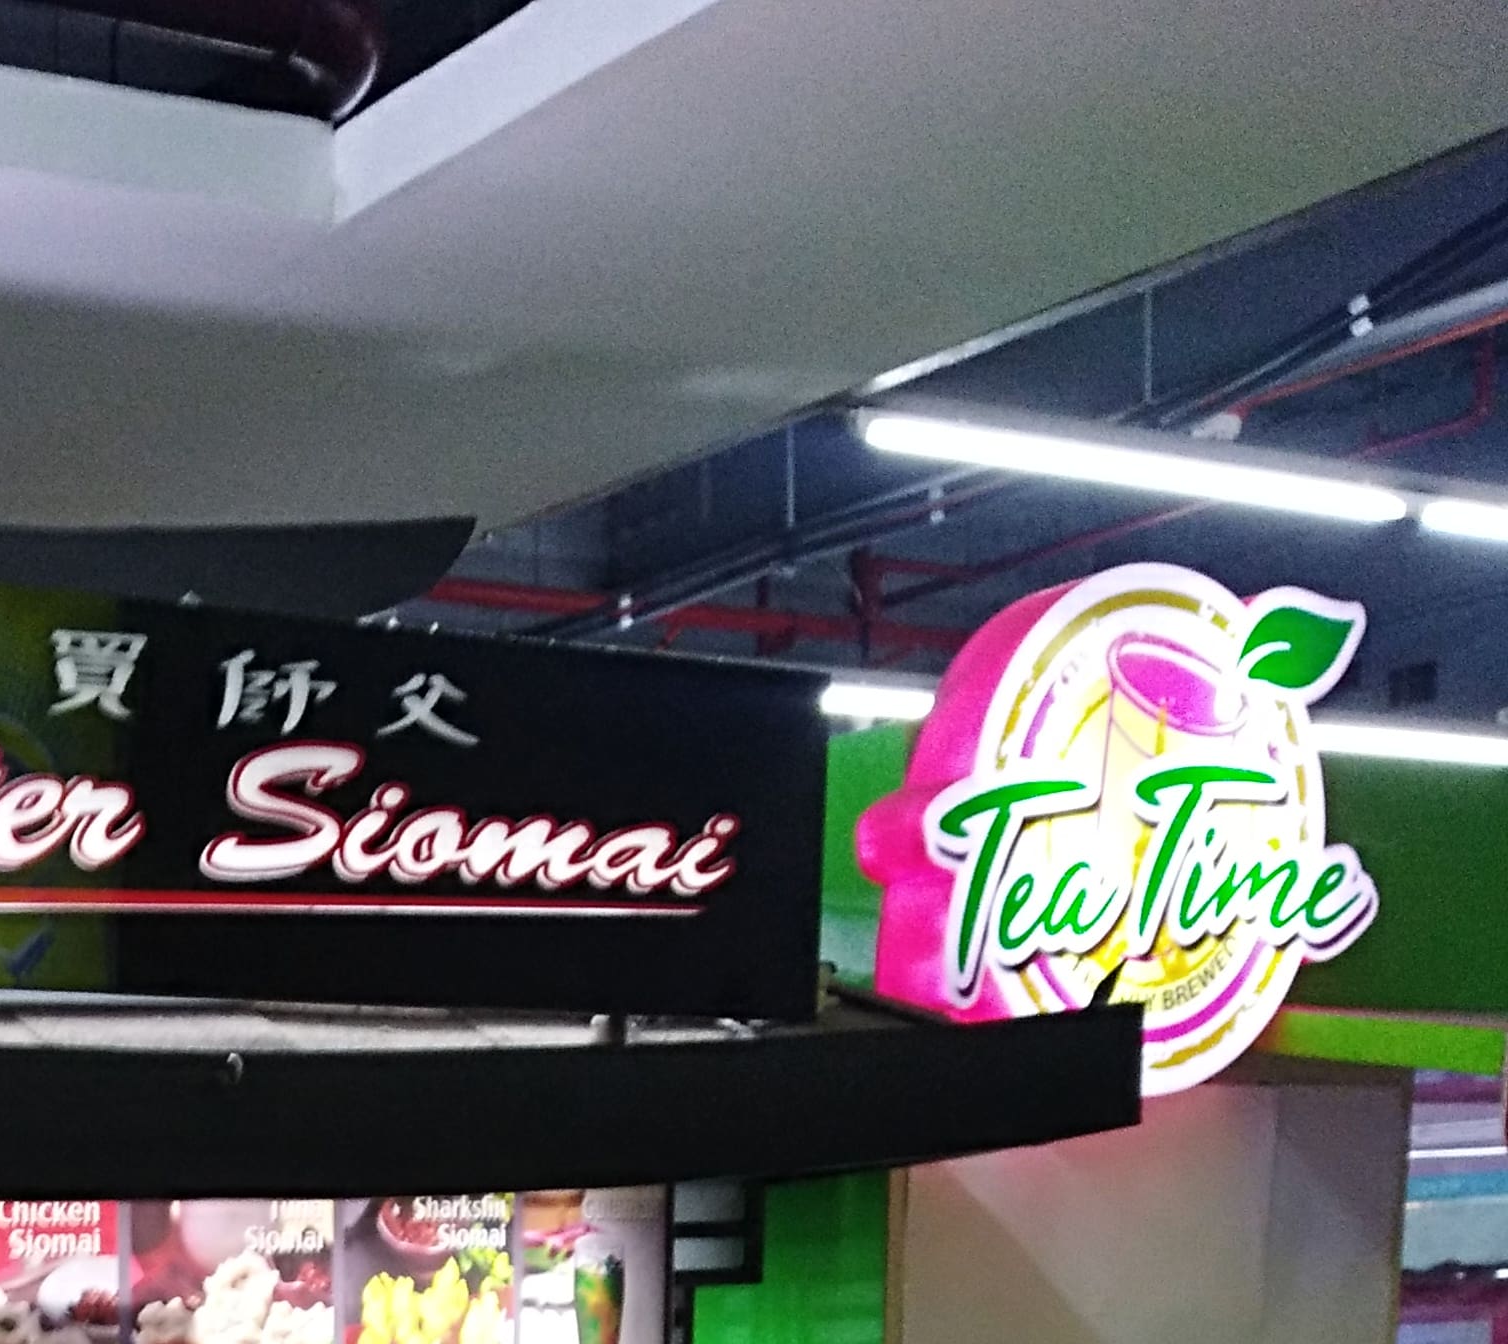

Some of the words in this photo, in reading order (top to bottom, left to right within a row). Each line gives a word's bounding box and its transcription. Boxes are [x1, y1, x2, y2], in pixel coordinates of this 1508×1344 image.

[199, 742, 738, 893] Siomai
[939, 780, 1120, 974] Tea
[1136, 766, 1362, 938] Time
[8, 1228, 101, 1258] Siomai
[437, 1222, 507, 1249] Siomai
